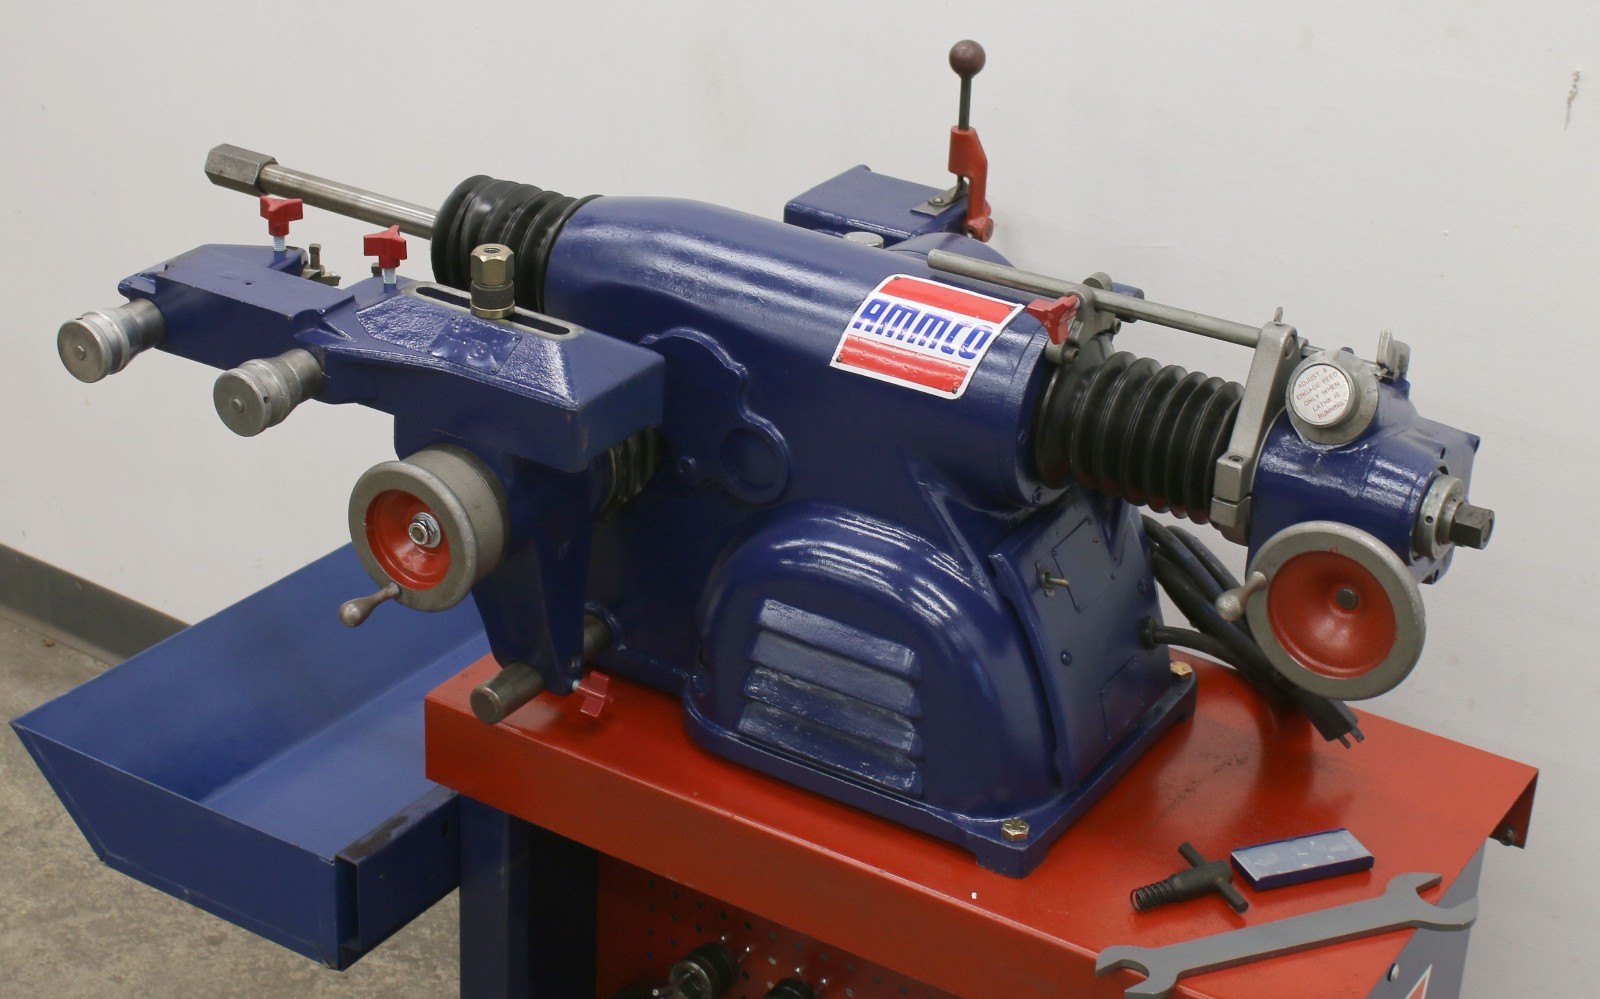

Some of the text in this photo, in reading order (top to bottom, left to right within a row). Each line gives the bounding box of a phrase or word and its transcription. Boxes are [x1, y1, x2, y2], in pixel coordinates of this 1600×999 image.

[1296, 371, 1338, 401] ENGAGE FEED
[1297, 371, 1320, 388] ADJUST
[1303, 381, 1340, 407] ONLY WHEN
[1312, 397, 1332, 412] LATHE
[1317, 401, 1344, 419] RUNNING
